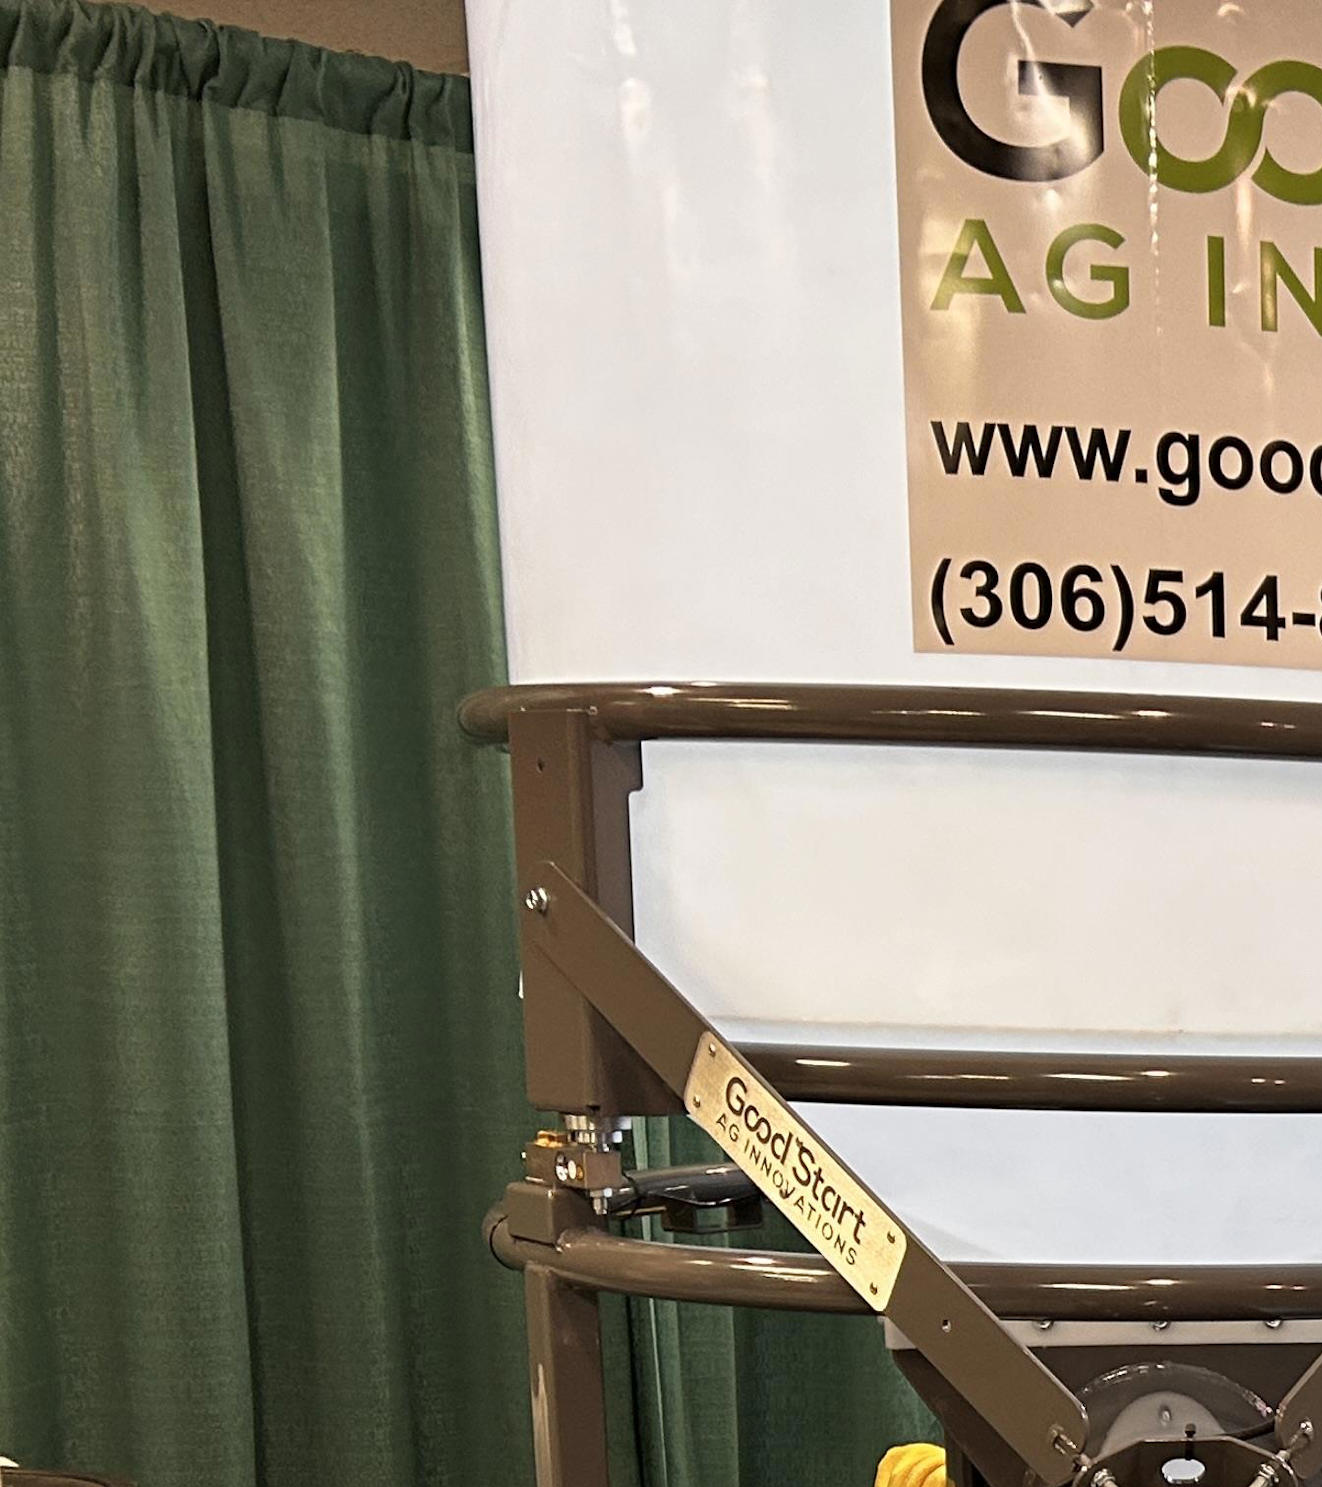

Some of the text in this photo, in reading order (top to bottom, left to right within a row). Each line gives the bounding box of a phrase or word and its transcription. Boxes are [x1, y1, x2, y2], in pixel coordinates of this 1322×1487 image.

[929, 217, 1131, 321] AG
[716, 1113, 858, 1266] AG INNOVATIONS
[726, 1077, 866, 1245] Good Start
